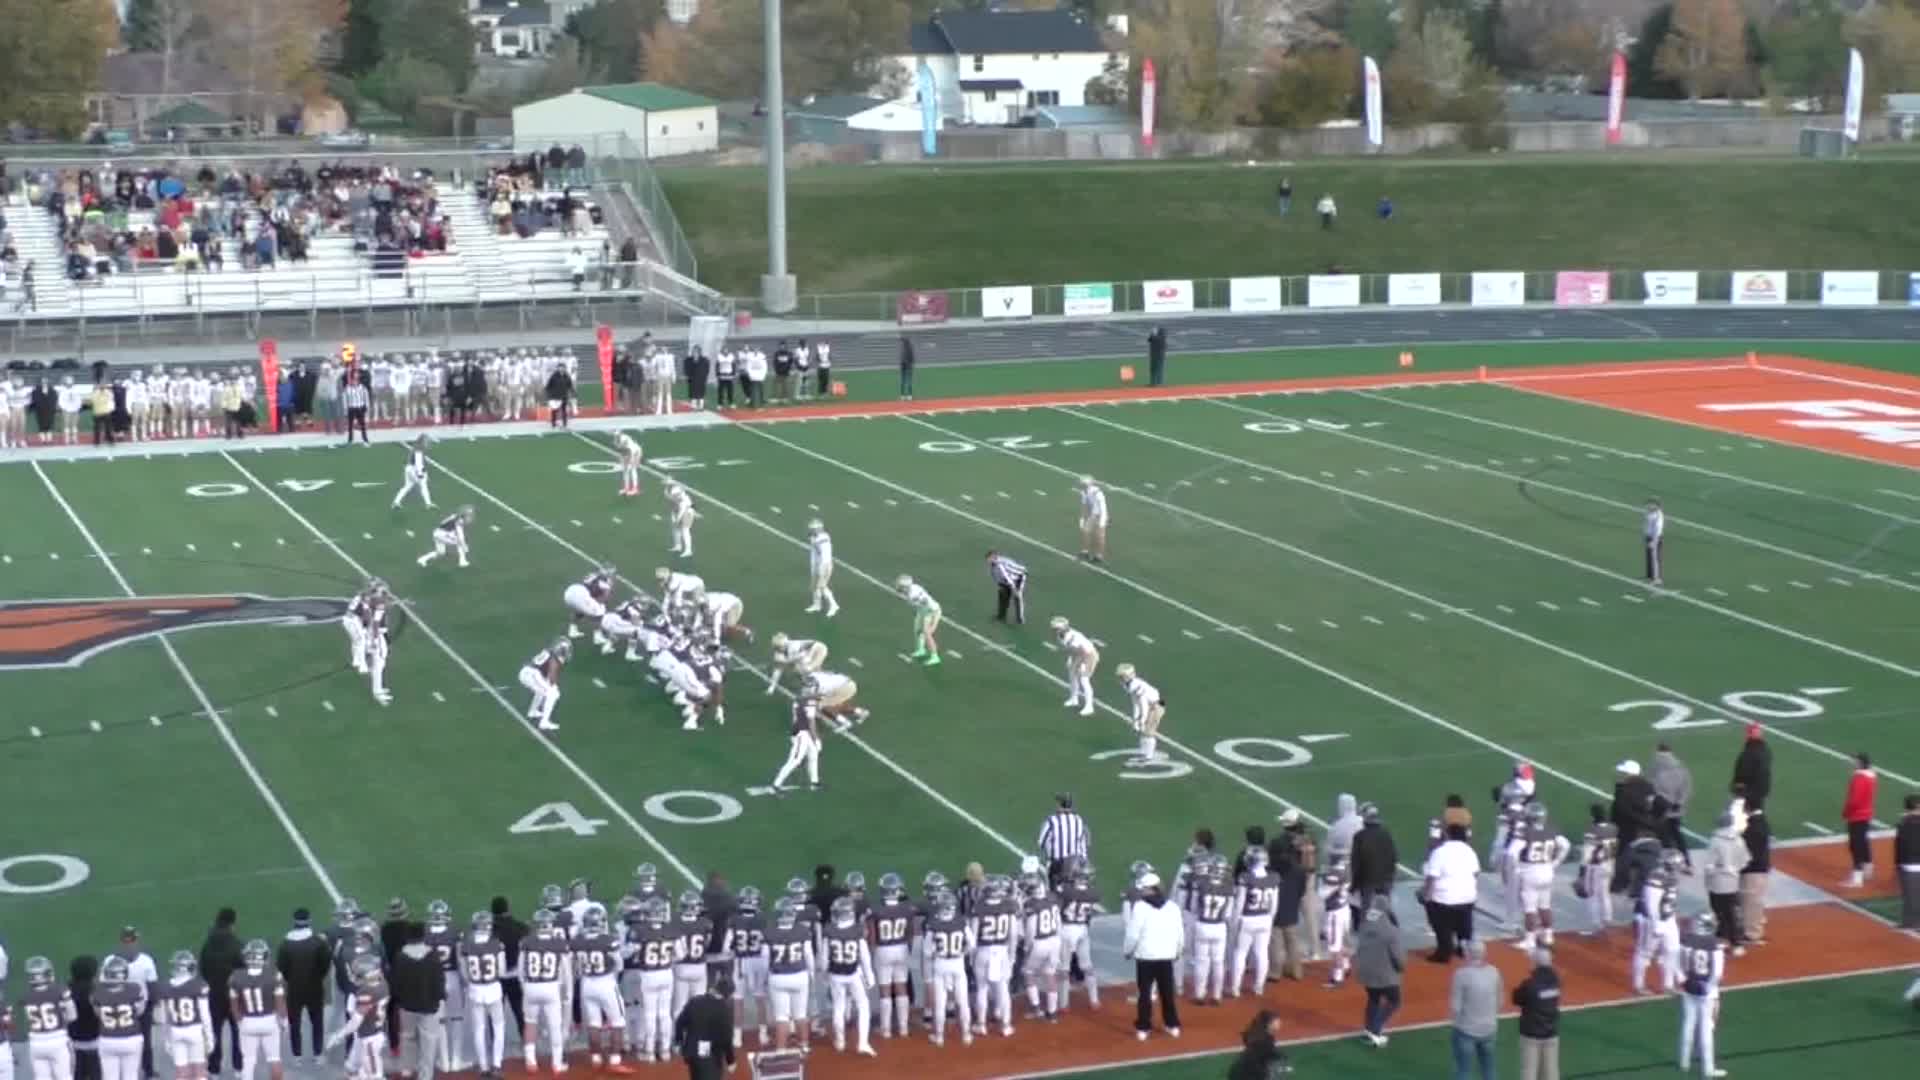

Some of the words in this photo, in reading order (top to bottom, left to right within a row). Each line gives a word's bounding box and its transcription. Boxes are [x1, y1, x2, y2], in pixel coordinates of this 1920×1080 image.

[1607, 690, 1825, 730] 20
[1088, 737, 1313, 779] 30
[507, 790, 733, 835] 40
[1203, 894, 1226, 919] 17
[982, 915, 1010, 941] 20
[645, 941, 673, 966] 65
[935, 931, 964, 957] 30
[468, 953, 497, 982] 83
[527, 950, 557, 979] 89
[243, 986, 263, 1014] 11
[24, 1003, 58, 1030] 56
